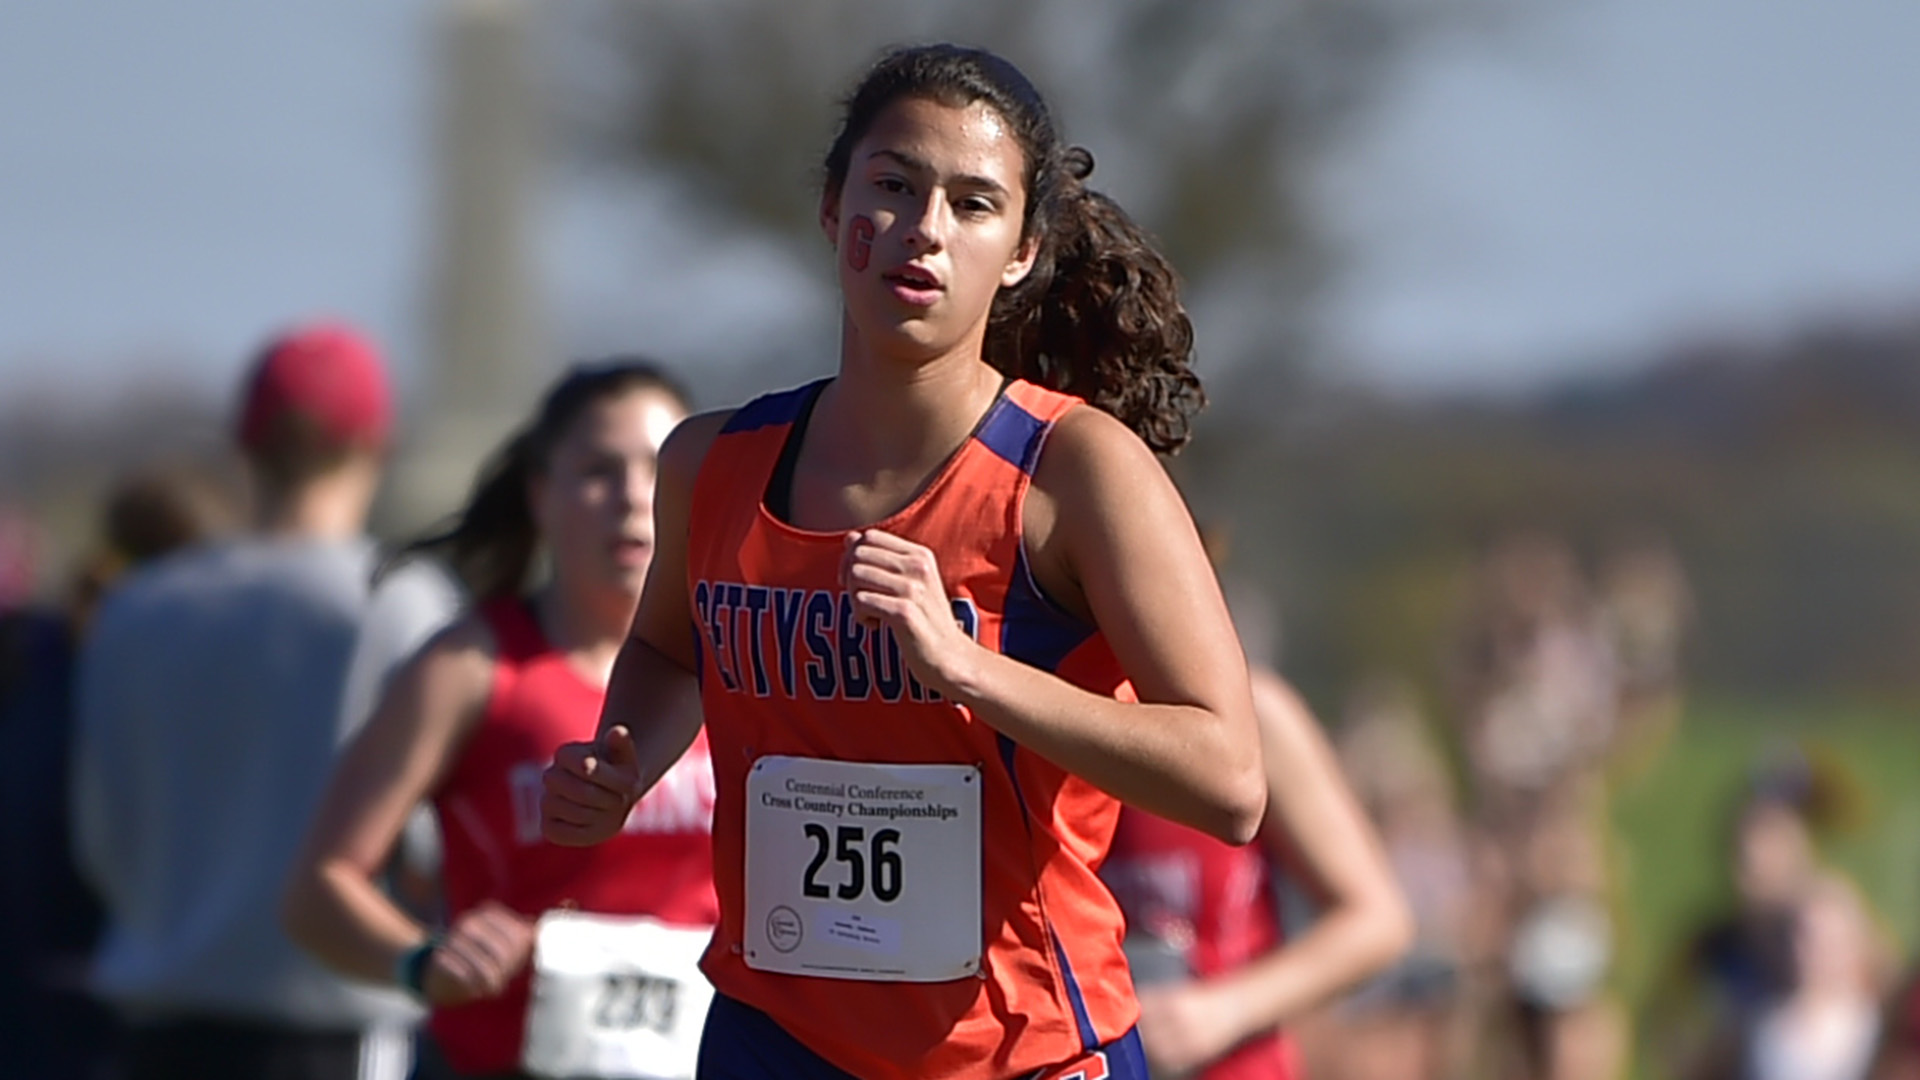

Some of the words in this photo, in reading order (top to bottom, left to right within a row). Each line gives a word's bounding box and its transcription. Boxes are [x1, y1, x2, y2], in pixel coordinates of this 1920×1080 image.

[694, 579, 979, 703] GETTYSBU
[761, 792, 793, 809] Cross
[794, 795, 844, 818] Country
[847, 802, 959, 821] Championships
[785, 778, 846, 798] Centennial
[847, 785, 924, 801] Conference
[802, 822, 903, 903] 256
